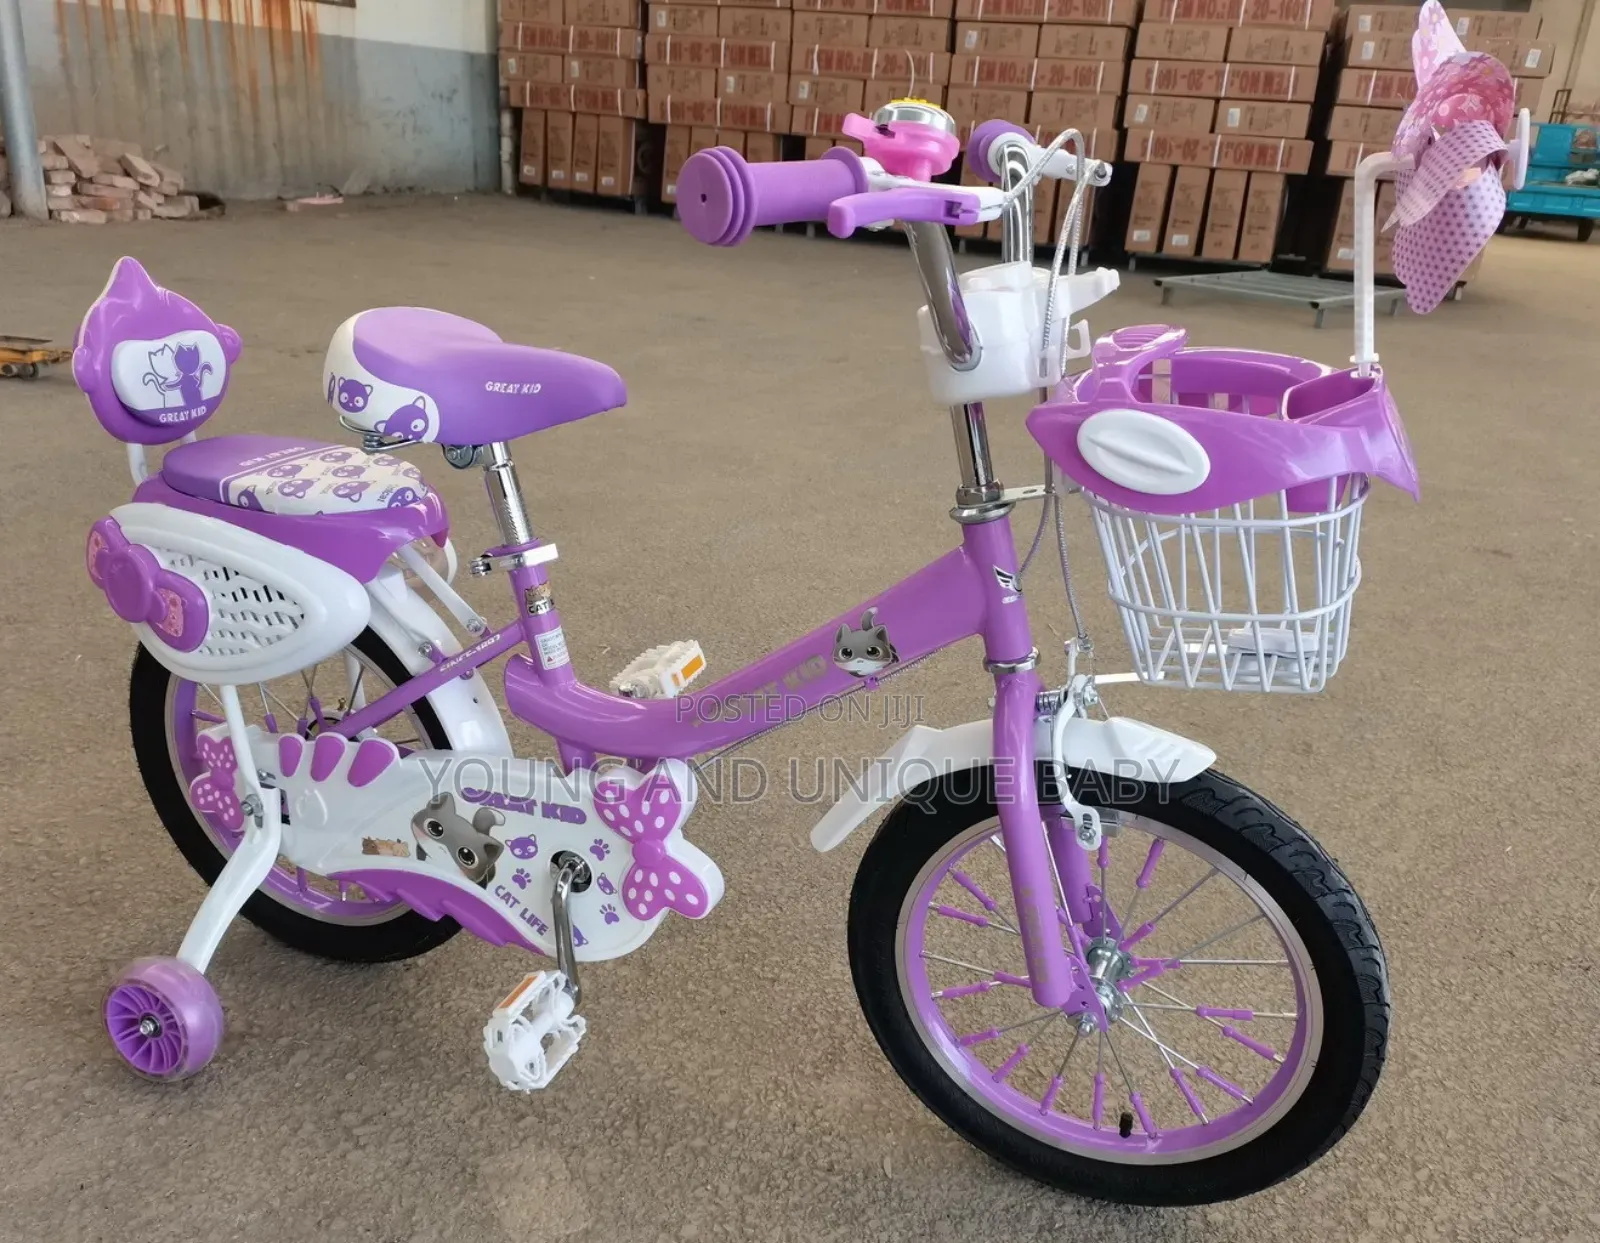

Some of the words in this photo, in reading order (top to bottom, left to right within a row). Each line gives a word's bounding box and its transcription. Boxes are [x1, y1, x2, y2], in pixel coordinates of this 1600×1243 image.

[484, 381, 521, 394] GREAT
[521, 383, 542, 395] KID
[159, 410, 189, 423] GREAT
[191, 405, 207, 419] KID
[541, 801, 587, 825] KID
[494, 885, 521, 908] CAT
[519, 907, 549, 936] LIFE
